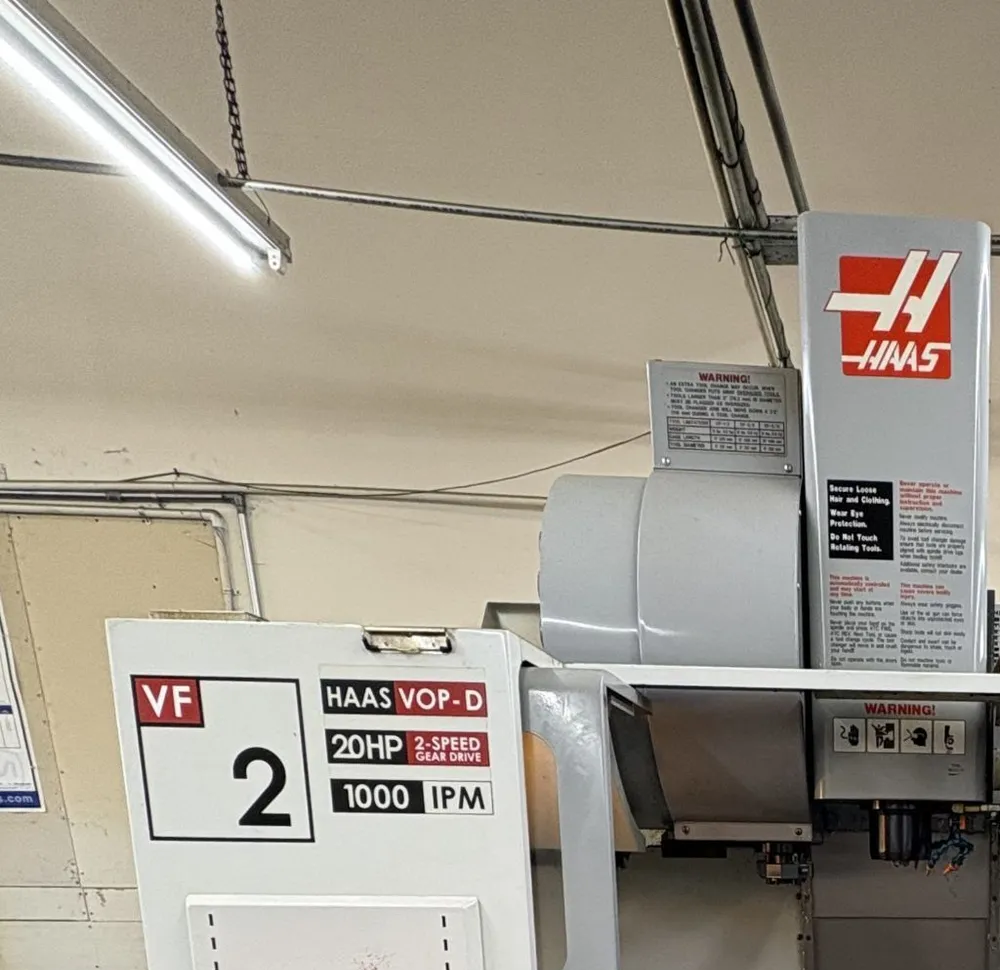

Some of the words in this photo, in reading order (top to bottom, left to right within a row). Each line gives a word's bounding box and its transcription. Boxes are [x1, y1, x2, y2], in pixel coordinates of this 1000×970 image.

[841, 340, 951, 372] HAAS
[699, 372, 750, 384] WARNING!
[829, 485, 854, 493] Secure
[856, 485, 877, 494] Loose
[829, 495, 843, 503] Hair
[846, 496, 858, 504] and
[830, 509, 848, 518] Wear
[850, 509, 864, 519] Eye
[830, 519, 867, 528] Protection.
[830, 533, 840, 541] Do
[857, 534, 878, 542] Touch
[830, 543, 859, 553] Rotating
[862, 544, 882, 553] Tools.
[141, 684, 193, 718] VF
[326, 687, 391, 710] HAAS
[864, 702, 936, 716] WARNING!
[332, 734, 404, 760] 20HP
[414, 736, 481, 750] 2-SPEED
[415, 751, 447, 762] GEAR
[449, 752, 481, 763] DRIVE
[233, 746, 292, 827] 2
[343, 783, 409, 809] 1000
[431, 786, 486, 810] IPM
